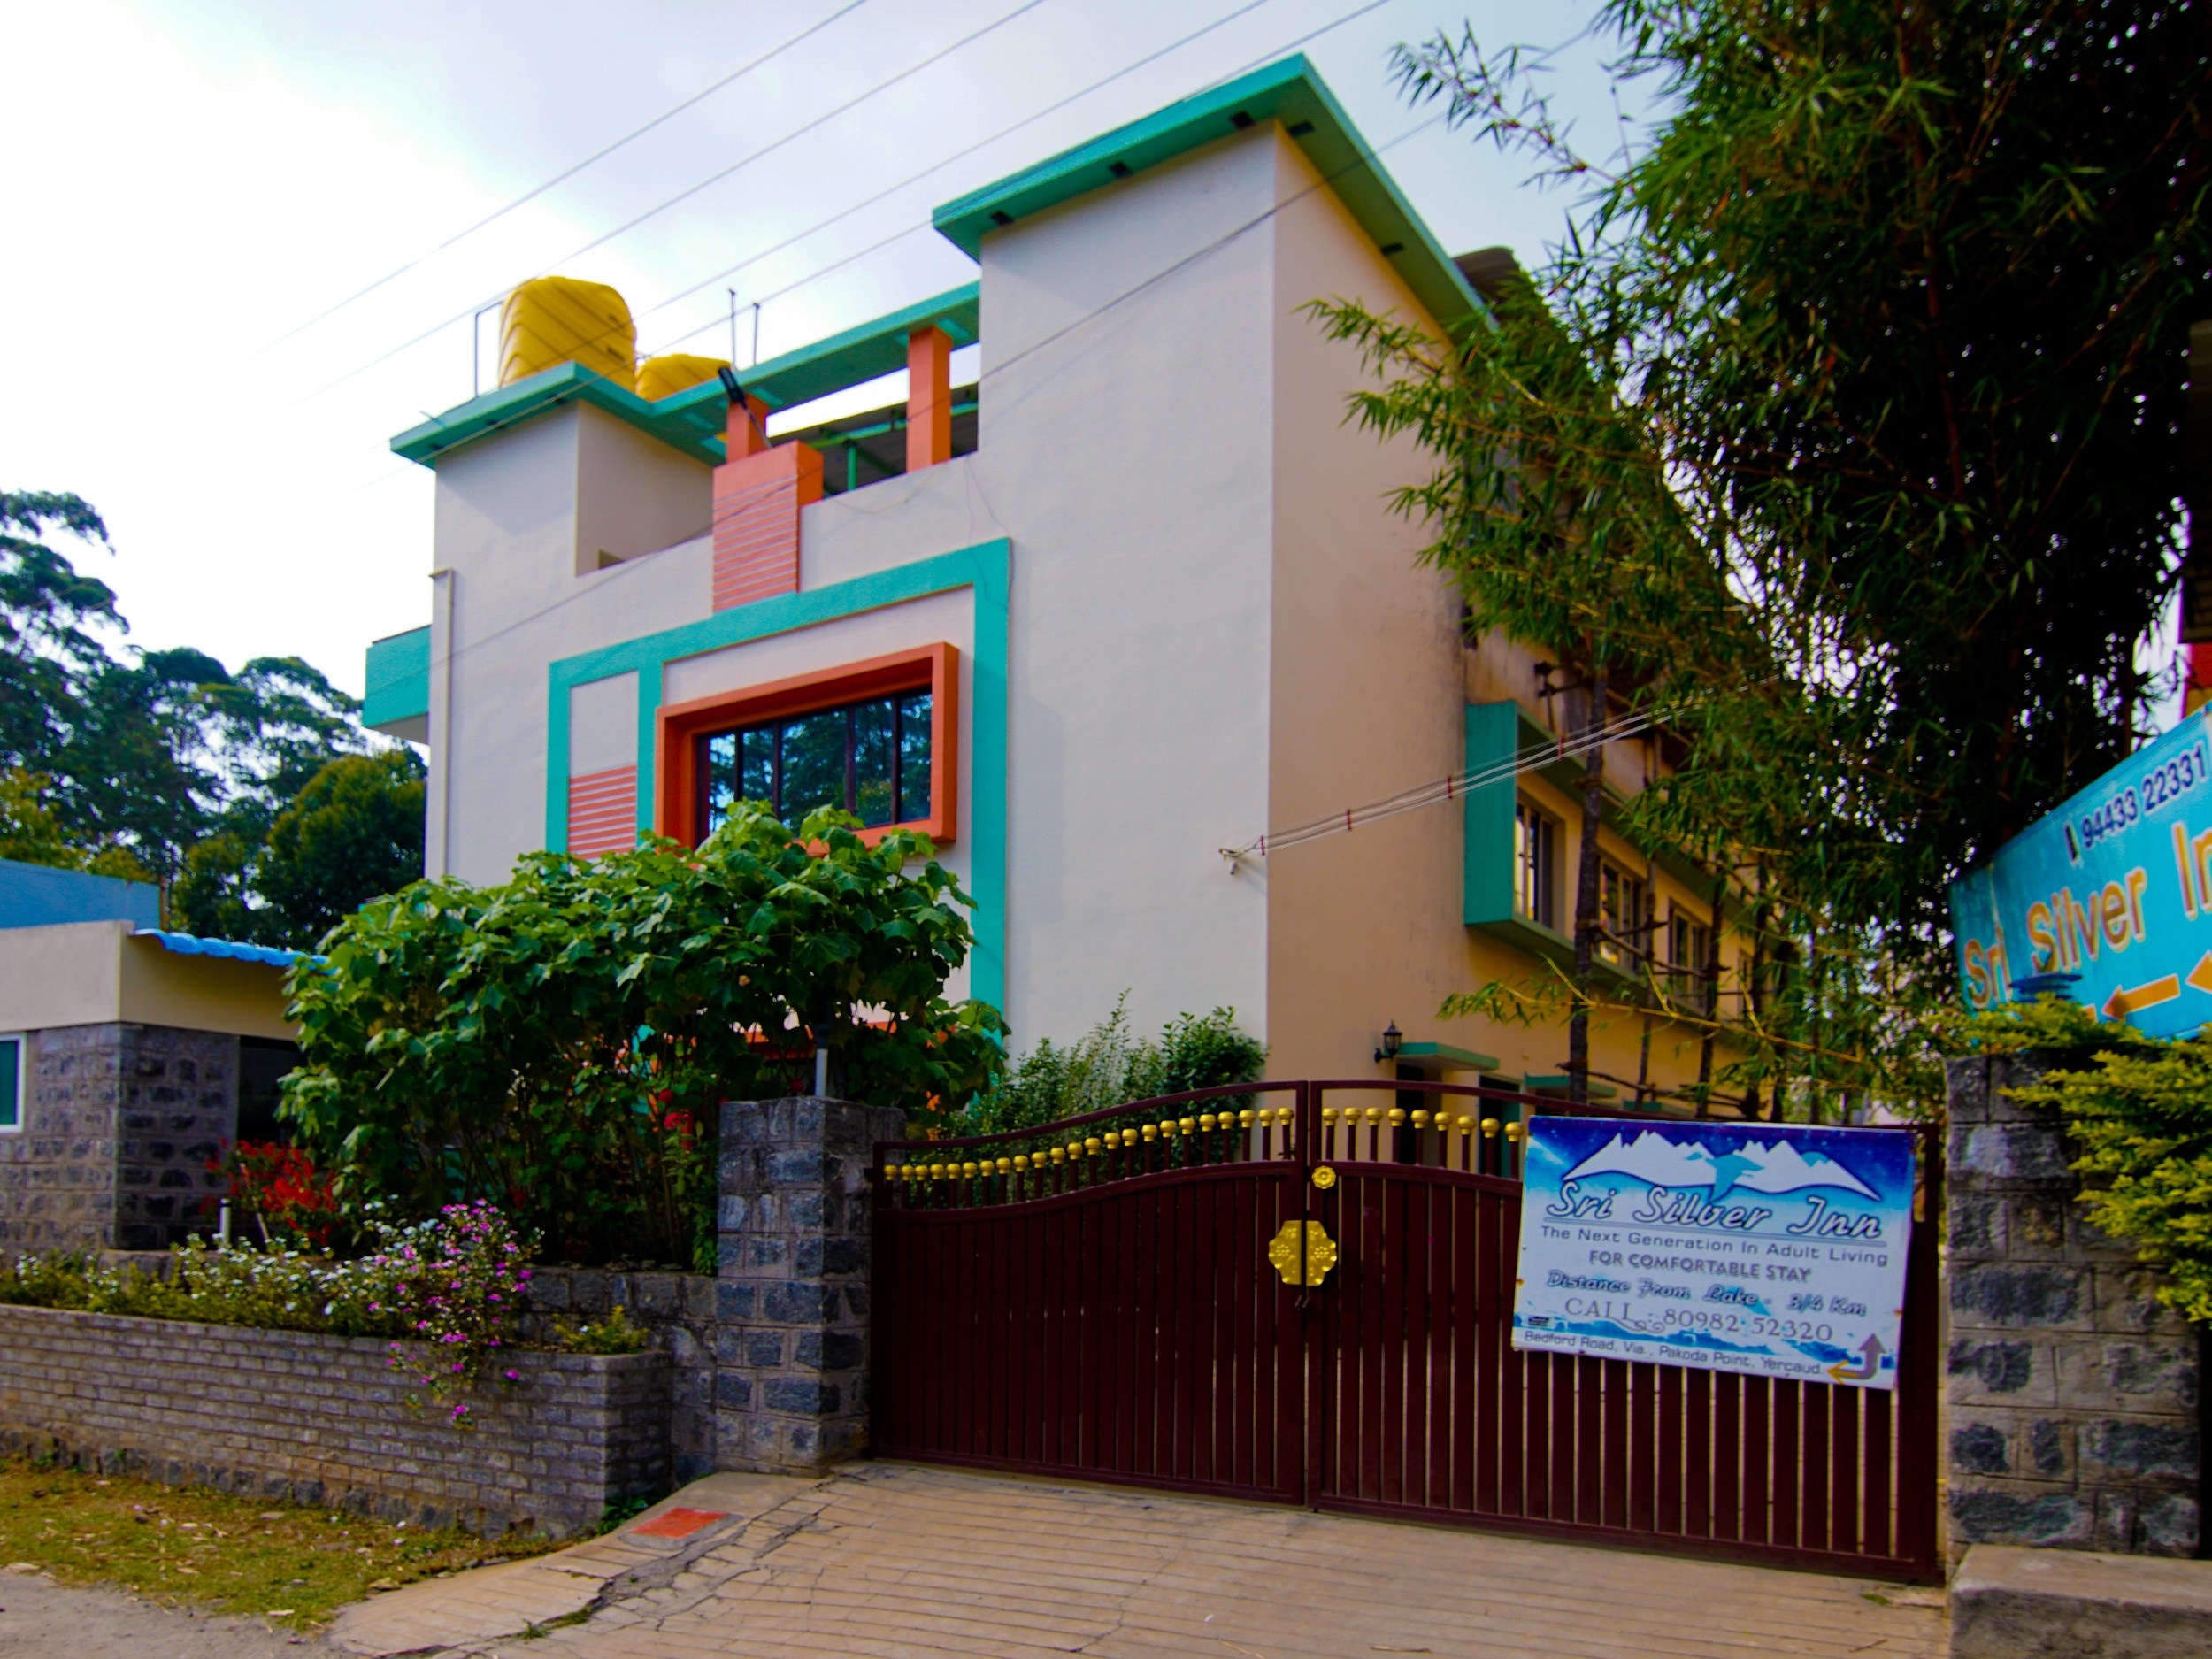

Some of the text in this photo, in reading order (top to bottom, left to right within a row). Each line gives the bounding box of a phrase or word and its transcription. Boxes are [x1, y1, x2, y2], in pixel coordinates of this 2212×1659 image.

[2081, 741, 2208, 849] 94433 22331
[1964, 925, 2012, 1009] Sri
[2027, 867, 2147, 973] Silver
[1547, 1180, 1882, 1239] Sri Silver Inn
[1541, 1225, 1888, 1267] The Next Generation In Adult Living
[1589, 1250, 1812, 1282] FOR COMFORTABLE STAY
[1547, 1269, 1632, 1294] Distance
[1637, 1277, 1691, 1299] From
[1702, 1283, 1760, 1306] Lake
[1828, 1296, 1868, 1317] Km
[1525, 1331, 1576, 1346] Bedford
[1659, 1345, 1709, 1363] Pakoda
[1663, 1308, 1740, 1333] 80982
[1751, 1317, 1833, 1342] 52320
